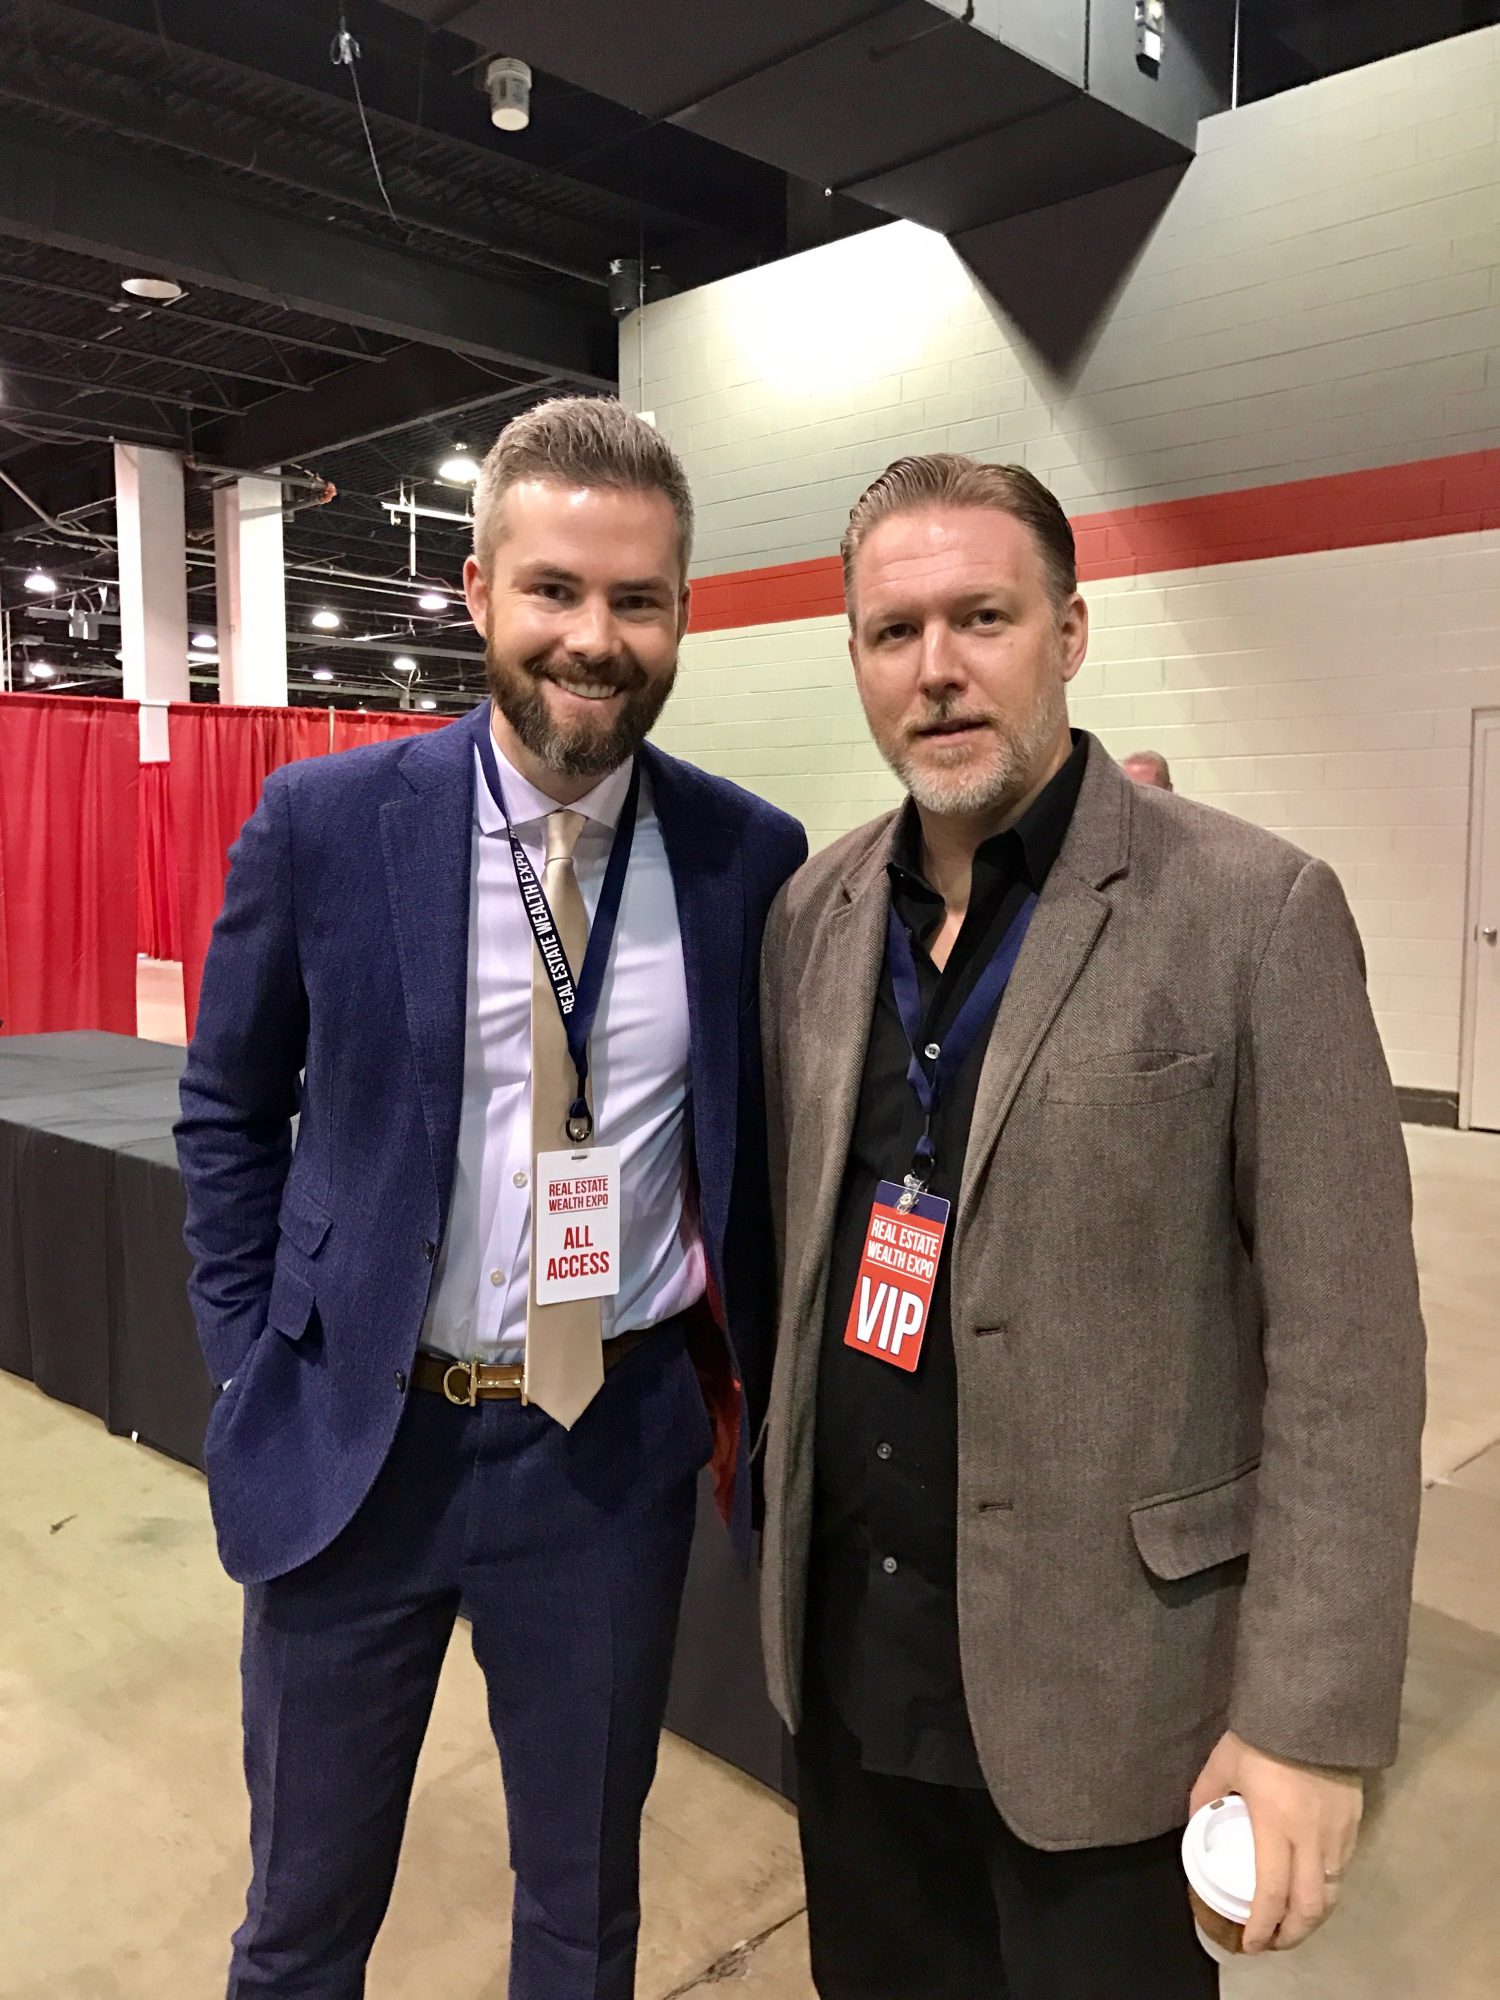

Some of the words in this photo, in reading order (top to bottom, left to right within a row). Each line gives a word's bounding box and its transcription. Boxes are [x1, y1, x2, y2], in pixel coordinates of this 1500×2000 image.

[514, 851, 535, 883] EXPO
[523, 884, 552, 936] WEALTH
[540, 934, 568, 981] ESTATE
[557, 980, 575, 1014] REAL
[549, 1182, 573, 1197] REAL
[575, 1178, 608, 1194] ESTATE
[549, 1196, 584, 1212] WEALTH
[586, 1193, 608, 1208] EXPO
[564, 1225, 593, 1250] ALL
[871, 1219, 897, 1244] REAL
[899, 1229, 940, 1257] ESTATE
[546, 1251, 610, 1281] ACCESS
[867, 1240, 906, 1269] WEALTH
[906, 1254, 934, 1279] EXPO
[856, 1275, 924, 1356] VIP
